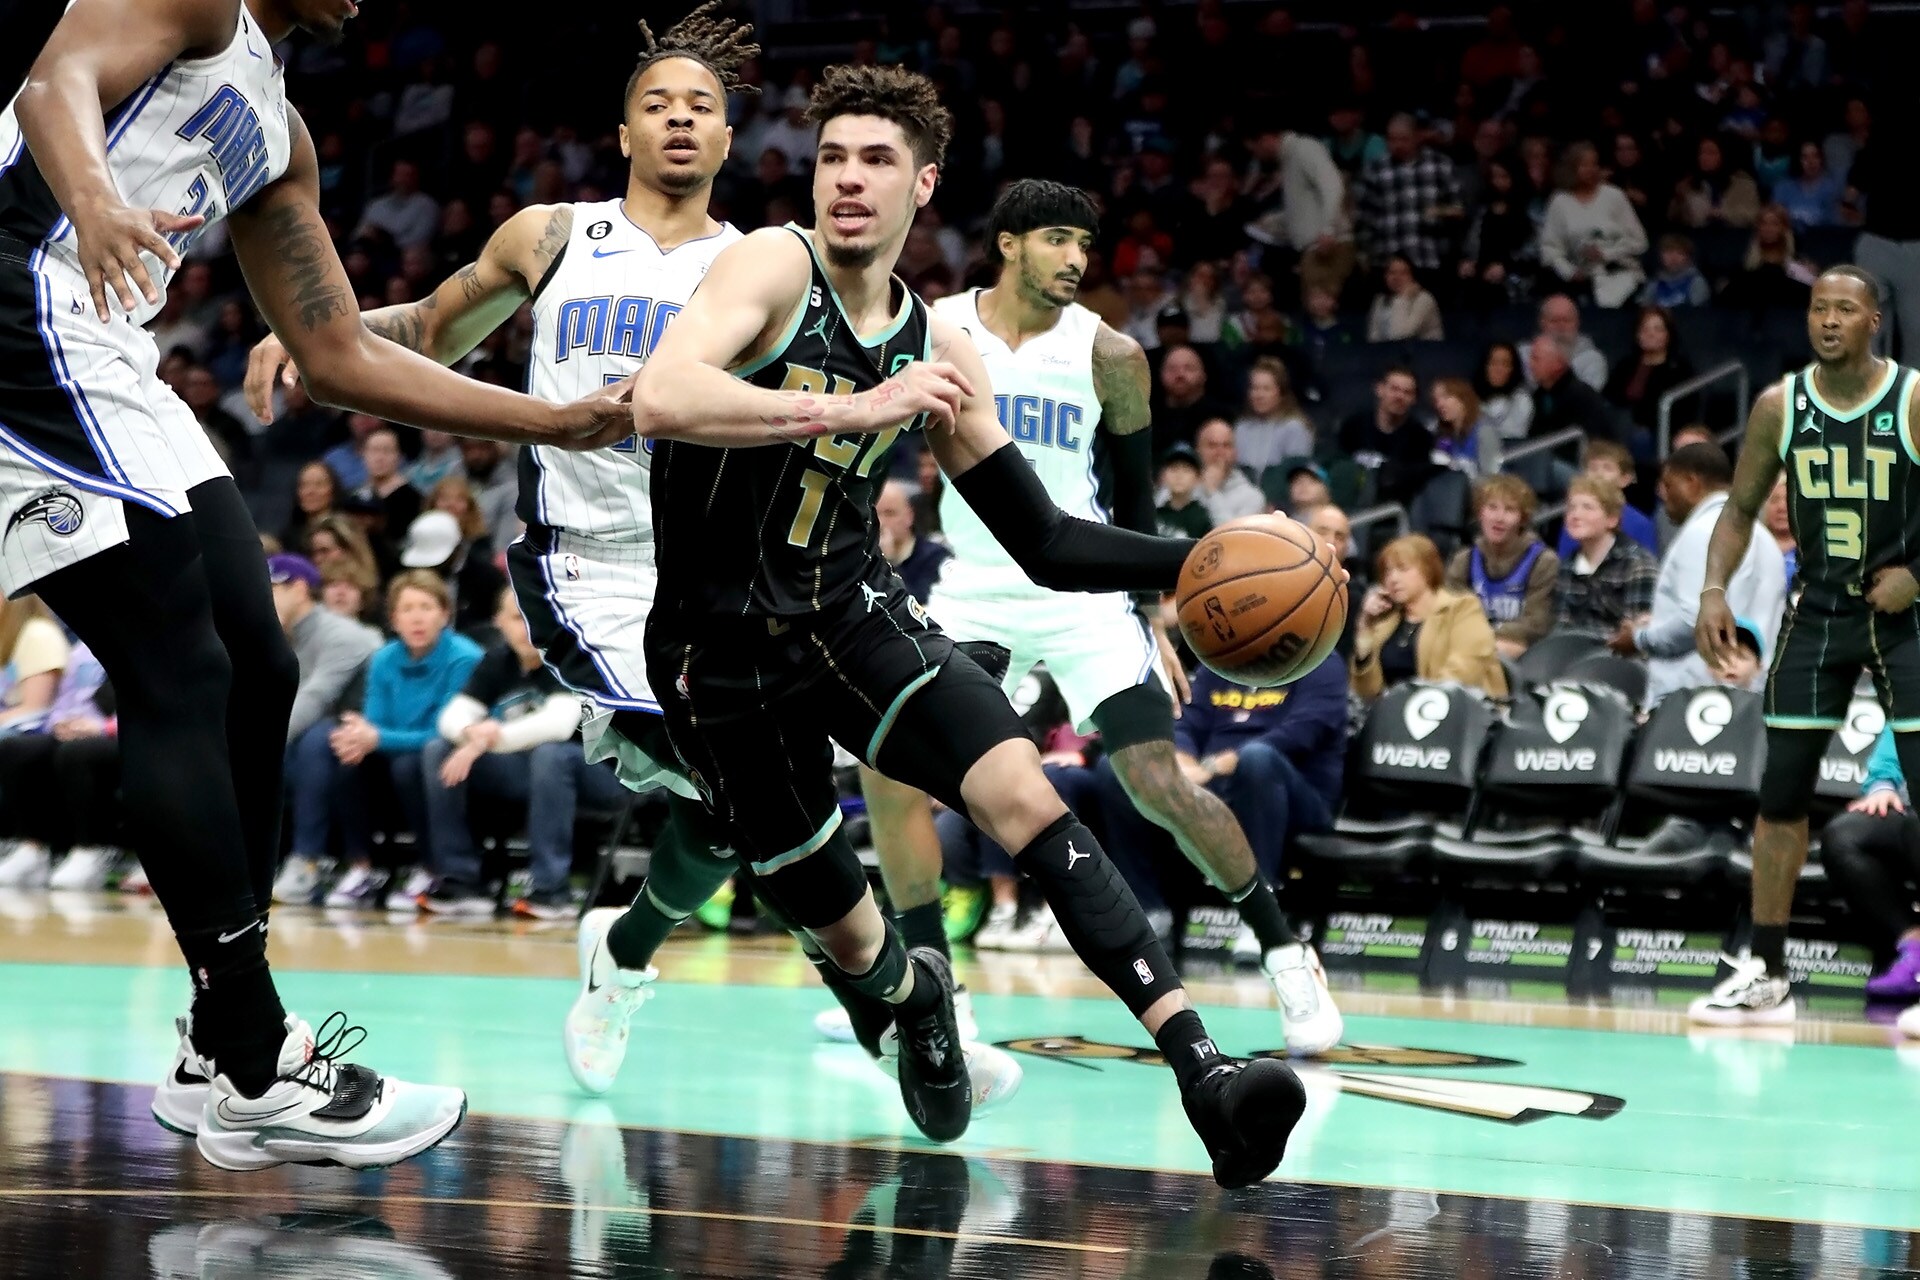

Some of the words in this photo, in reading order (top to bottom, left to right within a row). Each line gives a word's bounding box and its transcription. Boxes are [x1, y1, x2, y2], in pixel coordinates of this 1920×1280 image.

[590, 221, 609, 240] 6
[1796, 395, 1809, 412] 6
[1793, 446, 1897, 501] CLT
[787, 468, 833, 548] 1
[1826, 510, 1863, 561] 3
[1372, 743, 1451, 770] wave
[1514, 748, 1597, 771] wave
[1653, 748, 1738, 775] wave
[1326, 912, 1394, 932] UTILITY
[1472, 920, 1540, 940] UTILITY
[1320, 941, 1364, 955] GROUP
[1344, 930, 1426, 947] INNOVATION
[1440, 928, 1459, 951] 6
[1489, 939, 1573, 956] INNOVATION
[1585, 937, 1603, 960] 7
[1616, 929, 1685, 949] UTILITY
[1783, 937, 1839, 959] TILITY
[1464, 951, 1510, 964] GROUP
[1609, 960, 1657, 974] GROUP
[1634, 948, 1721, 966] INNOVATION
